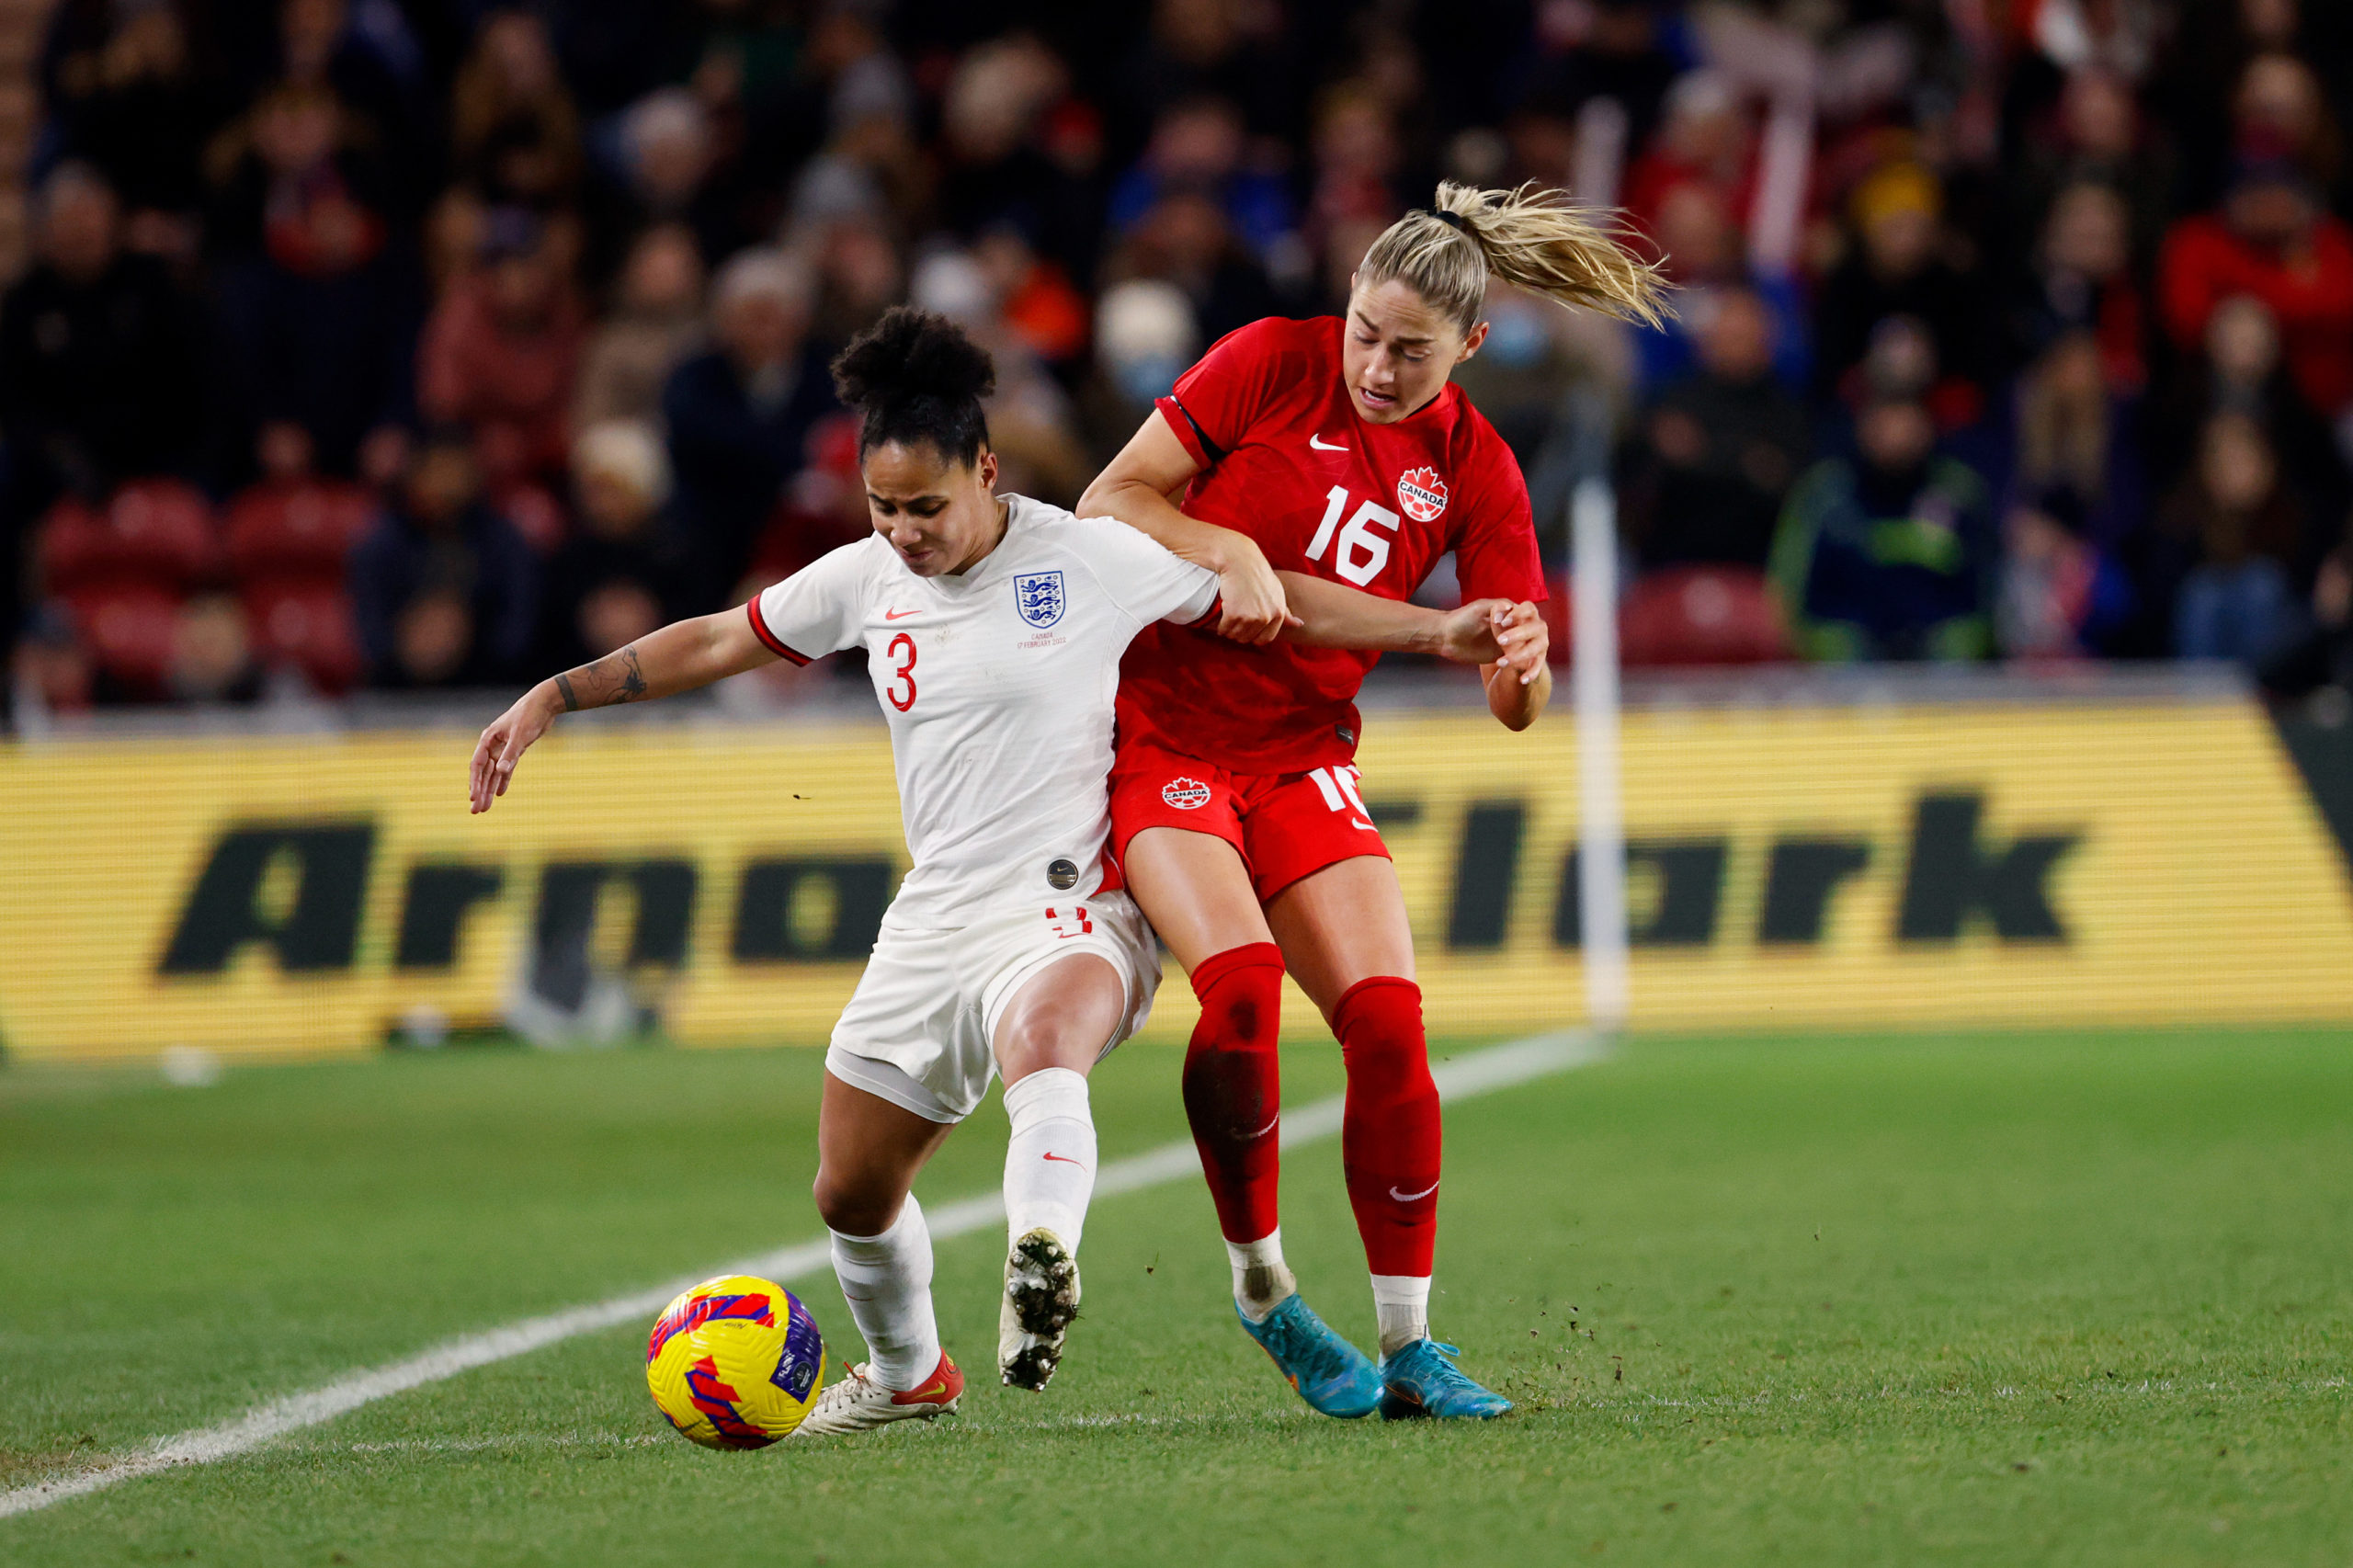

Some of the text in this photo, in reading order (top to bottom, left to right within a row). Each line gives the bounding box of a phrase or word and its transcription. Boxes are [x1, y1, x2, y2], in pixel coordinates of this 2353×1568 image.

[1399, 481, 1444, 507] CANADA
[1304, 484, 1400, 587] 16
[887, 632, 917, 712] 3
[1164, 790, 1208, 799] CANADA
[158, 790, 2079, 976] Arno lark
